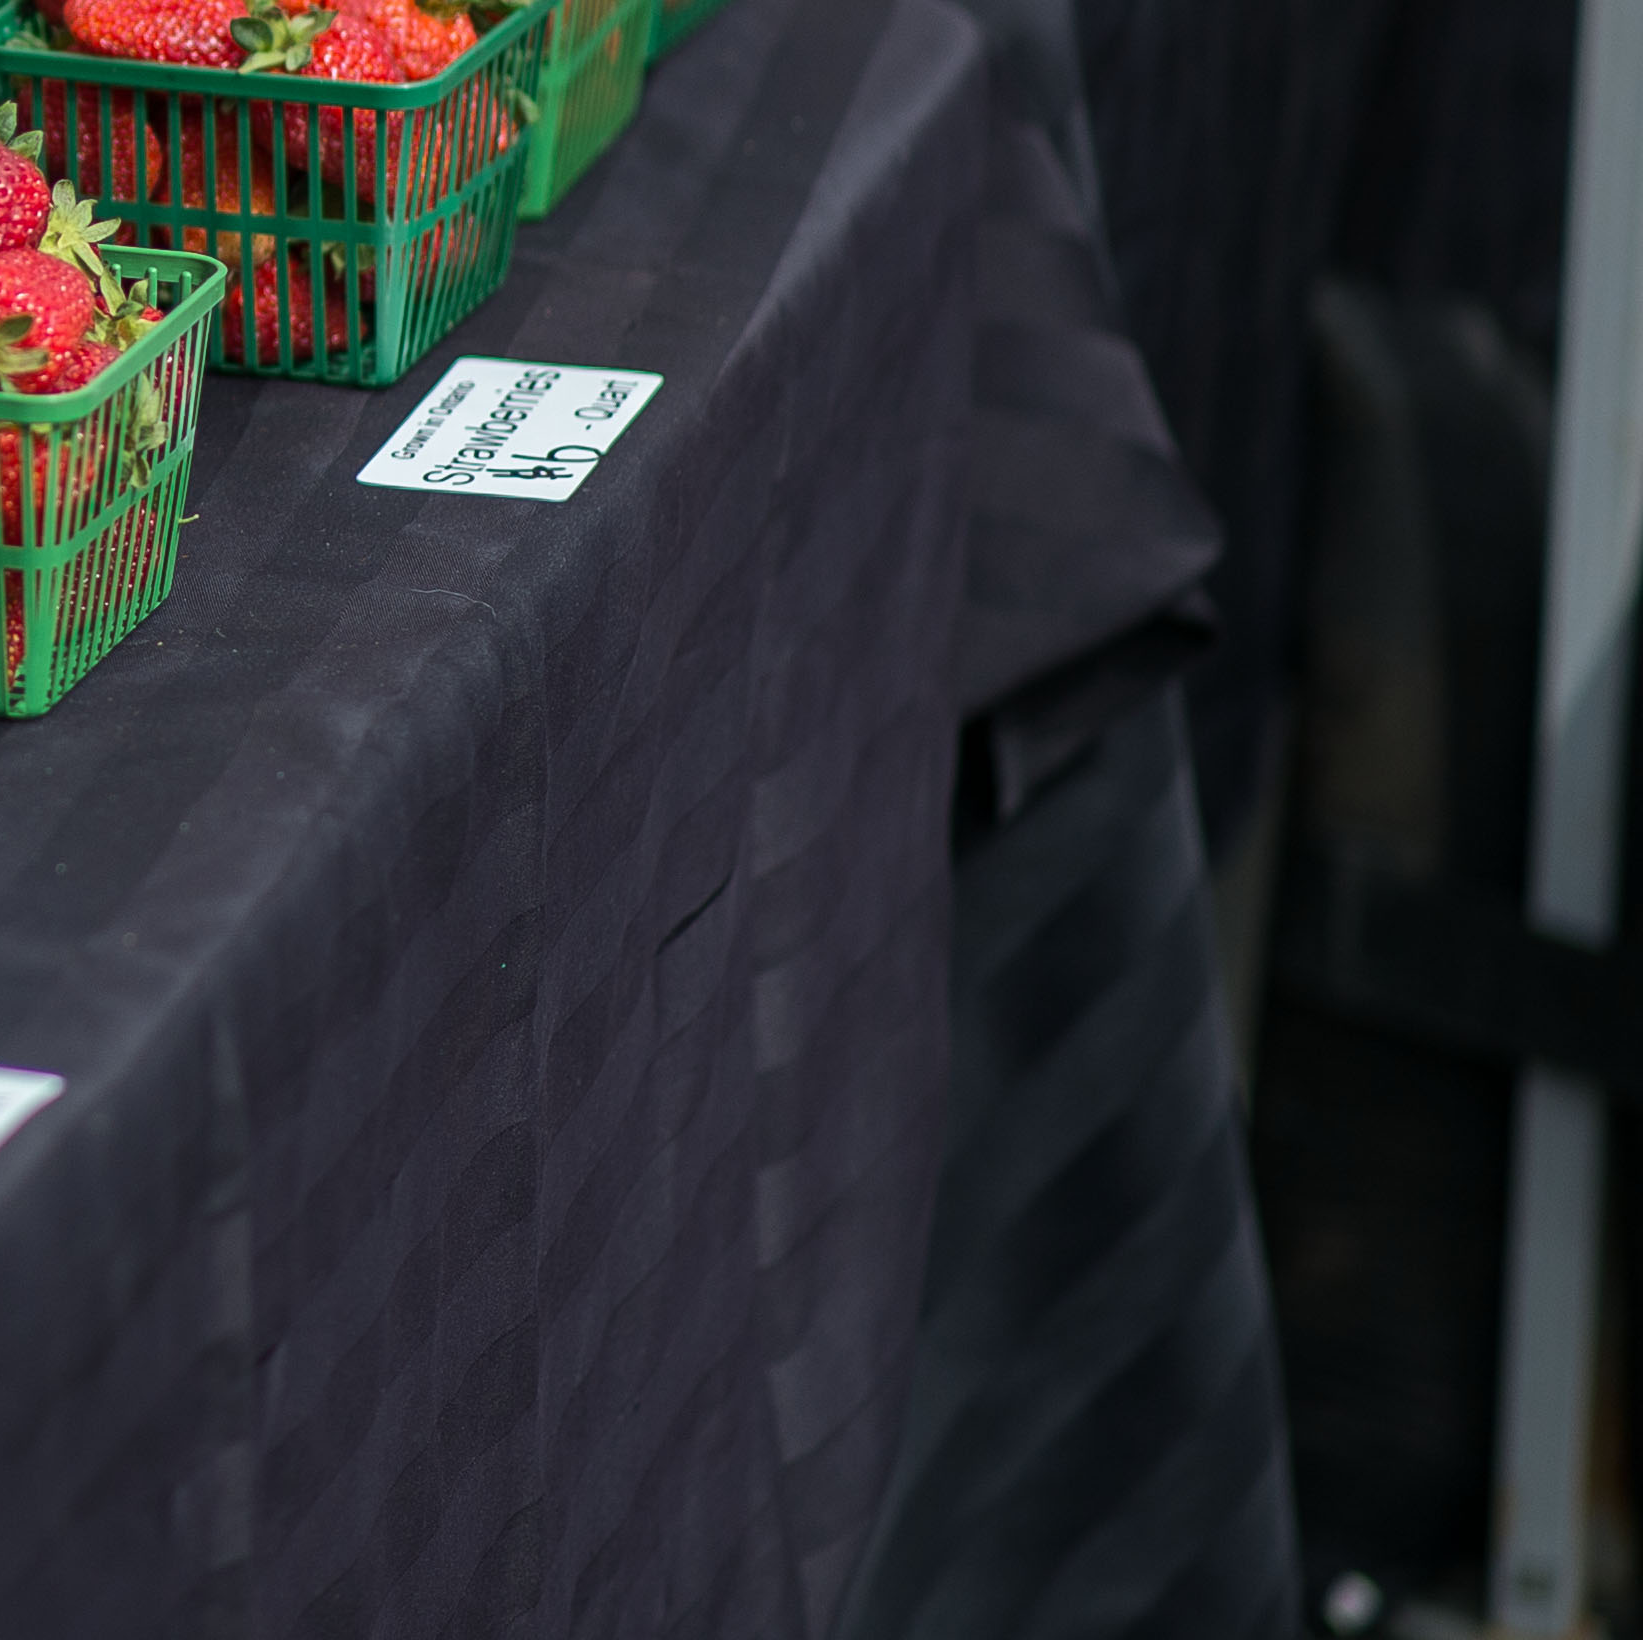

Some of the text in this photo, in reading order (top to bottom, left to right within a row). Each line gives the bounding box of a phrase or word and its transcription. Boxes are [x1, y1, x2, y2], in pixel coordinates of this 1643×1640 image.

[390, 428, 436, 460] Grown
[428, 381, 475, 416] Ontario
[422, 369, 561, 485] Strawberries
[574, 379, 639, 421] Quart
